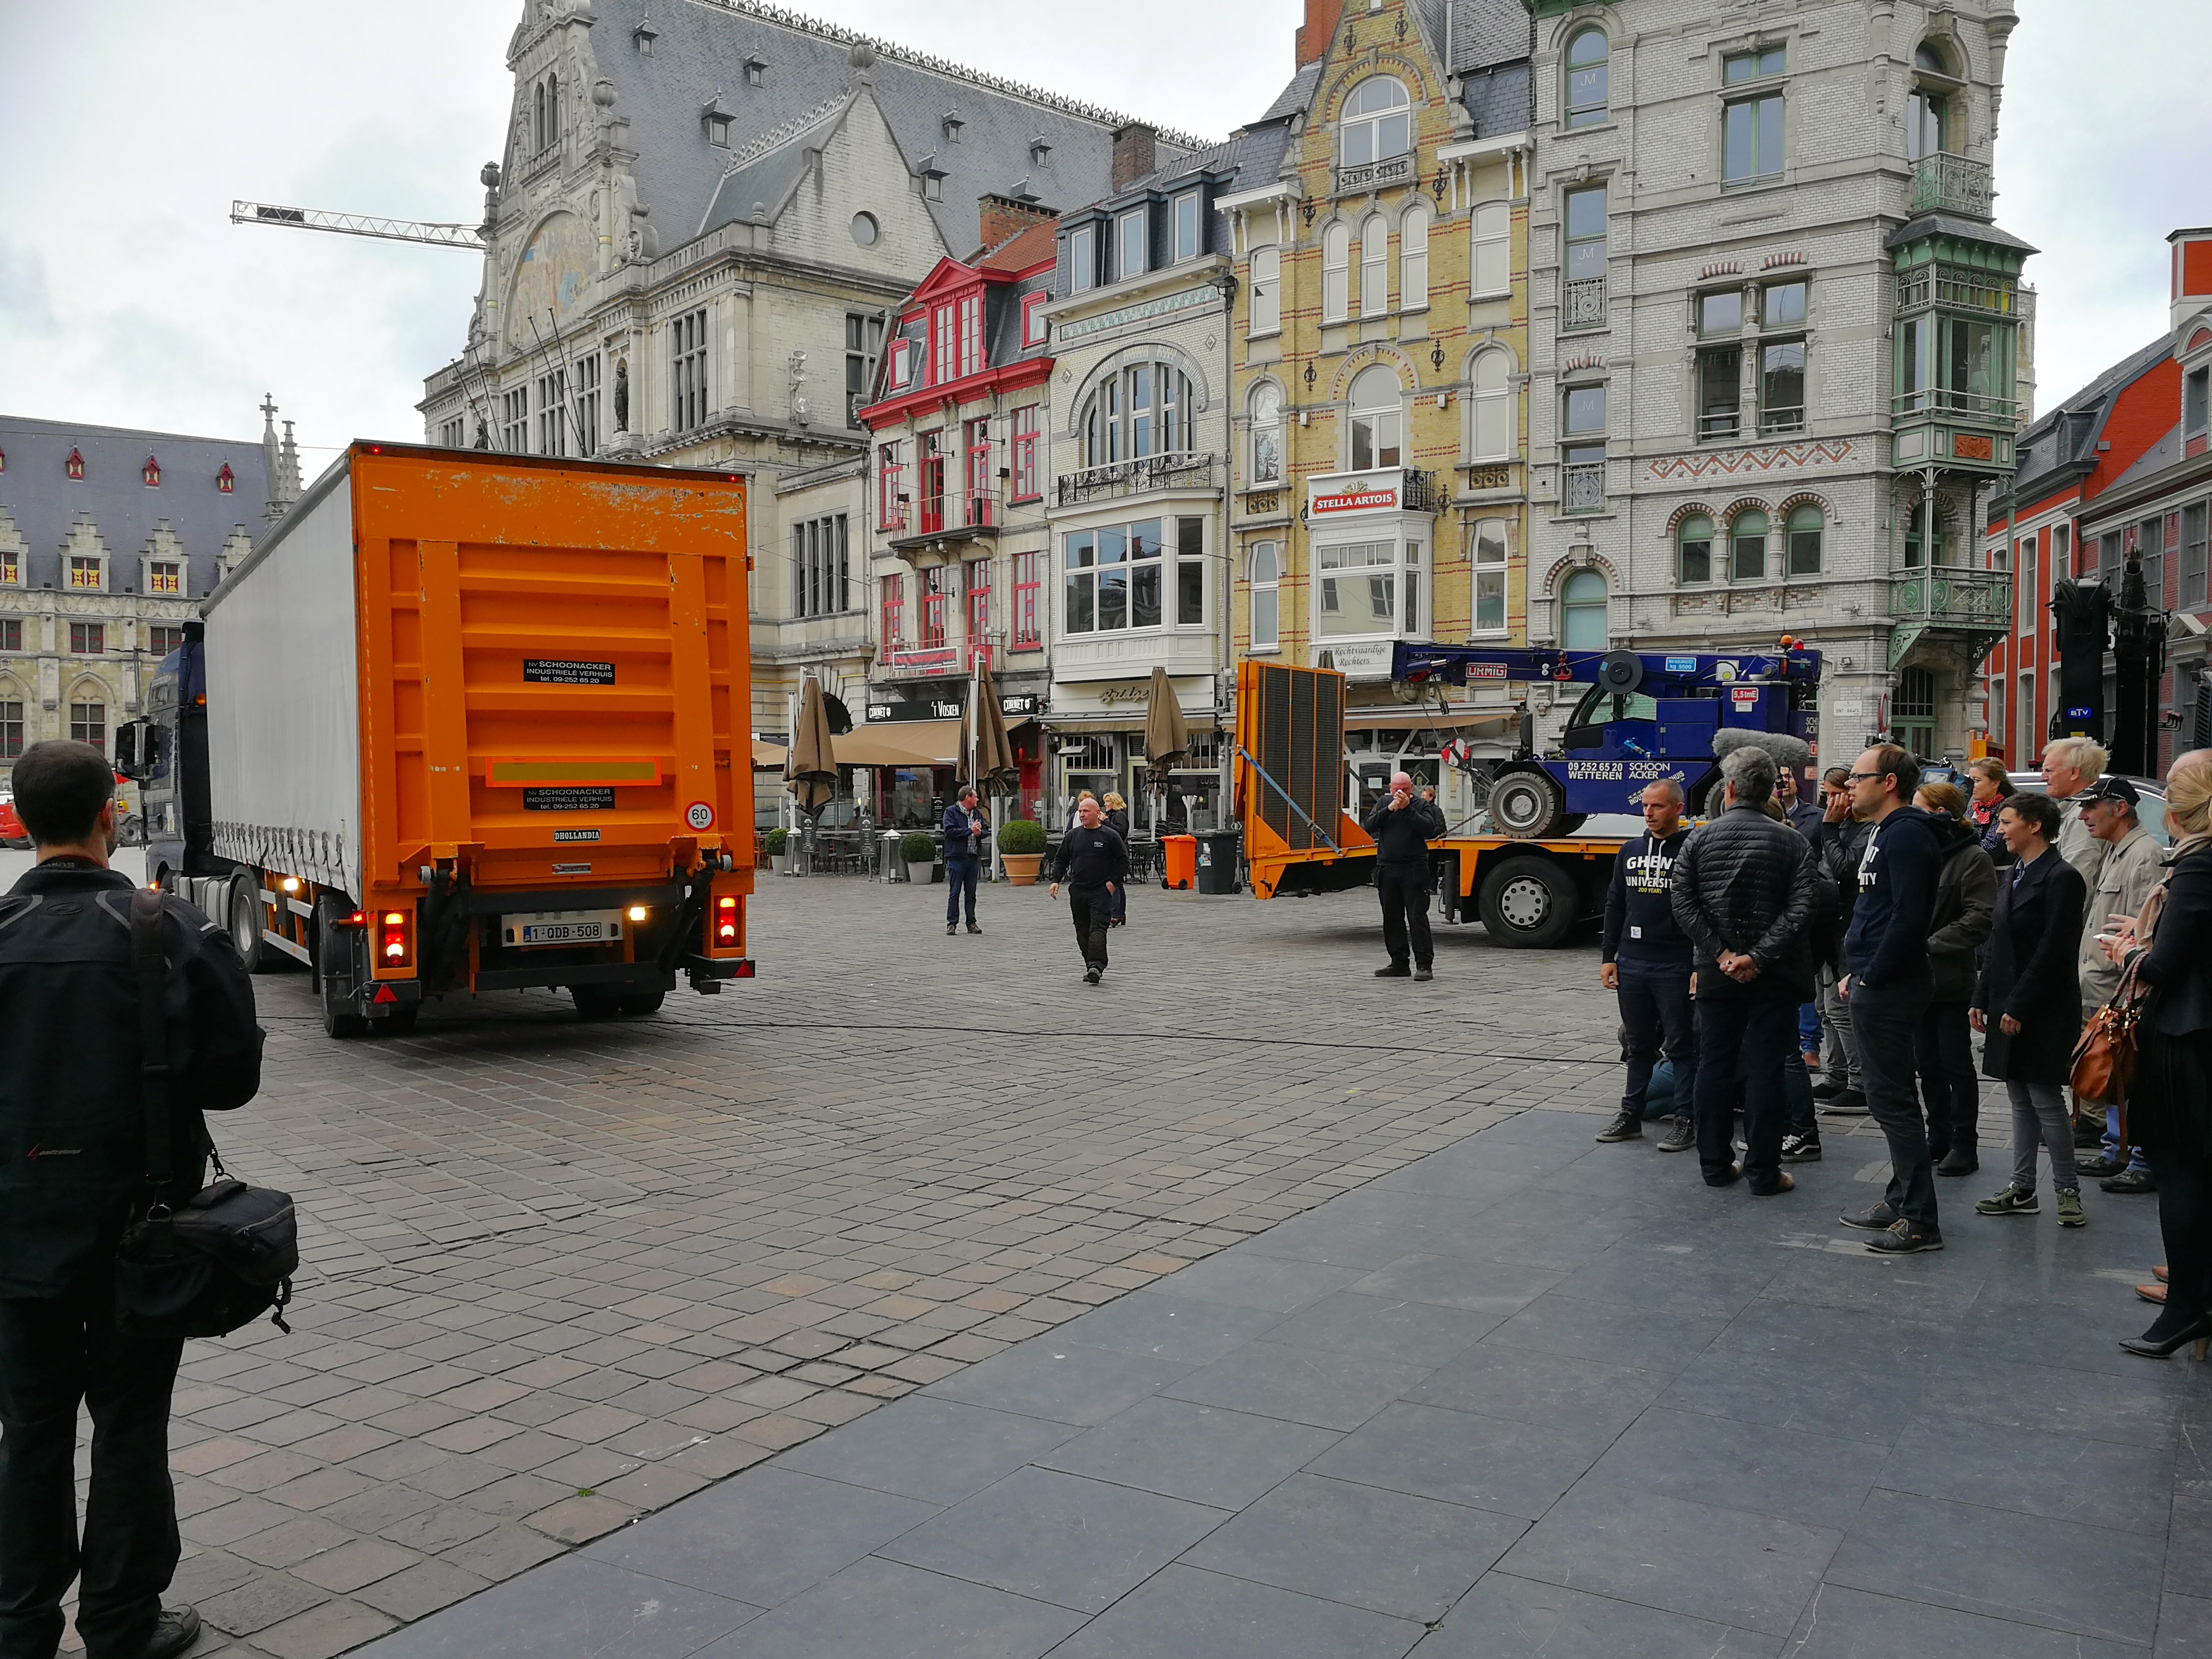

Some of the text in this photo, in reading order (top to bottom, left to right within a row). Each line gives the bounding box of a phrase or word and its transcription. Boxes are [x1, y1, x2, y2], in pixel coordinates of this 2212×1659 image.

[1317, 493, 1392, 508] STELLA ARTOIS
[1334, 644, 1386, 656] Rechtvaardige
[539, 661, 611, 670] SCHOONACKER
[1338, 656, 1370, 666] Rechters
[1099, 686, 1149, 705] Bridge
[1003, 698, 1024, 711] CORNET
[869, 706, 886, 718] CORNET
[1568, 762, 1623, 772] 09 252 65 20
[1629, 763, 1670, 771] SCHOON
[1568, 771, 1622, 780] WETTEREN
[1628, 771, 1658, 779] ACKER
[692, 808, 707, 820] 60
[555, 831, 600, 840] DHOLLANDIA
[1627, 855, 1677, 870] GHEN
[1626, 876, 1672, 889] UNIVERSIT
